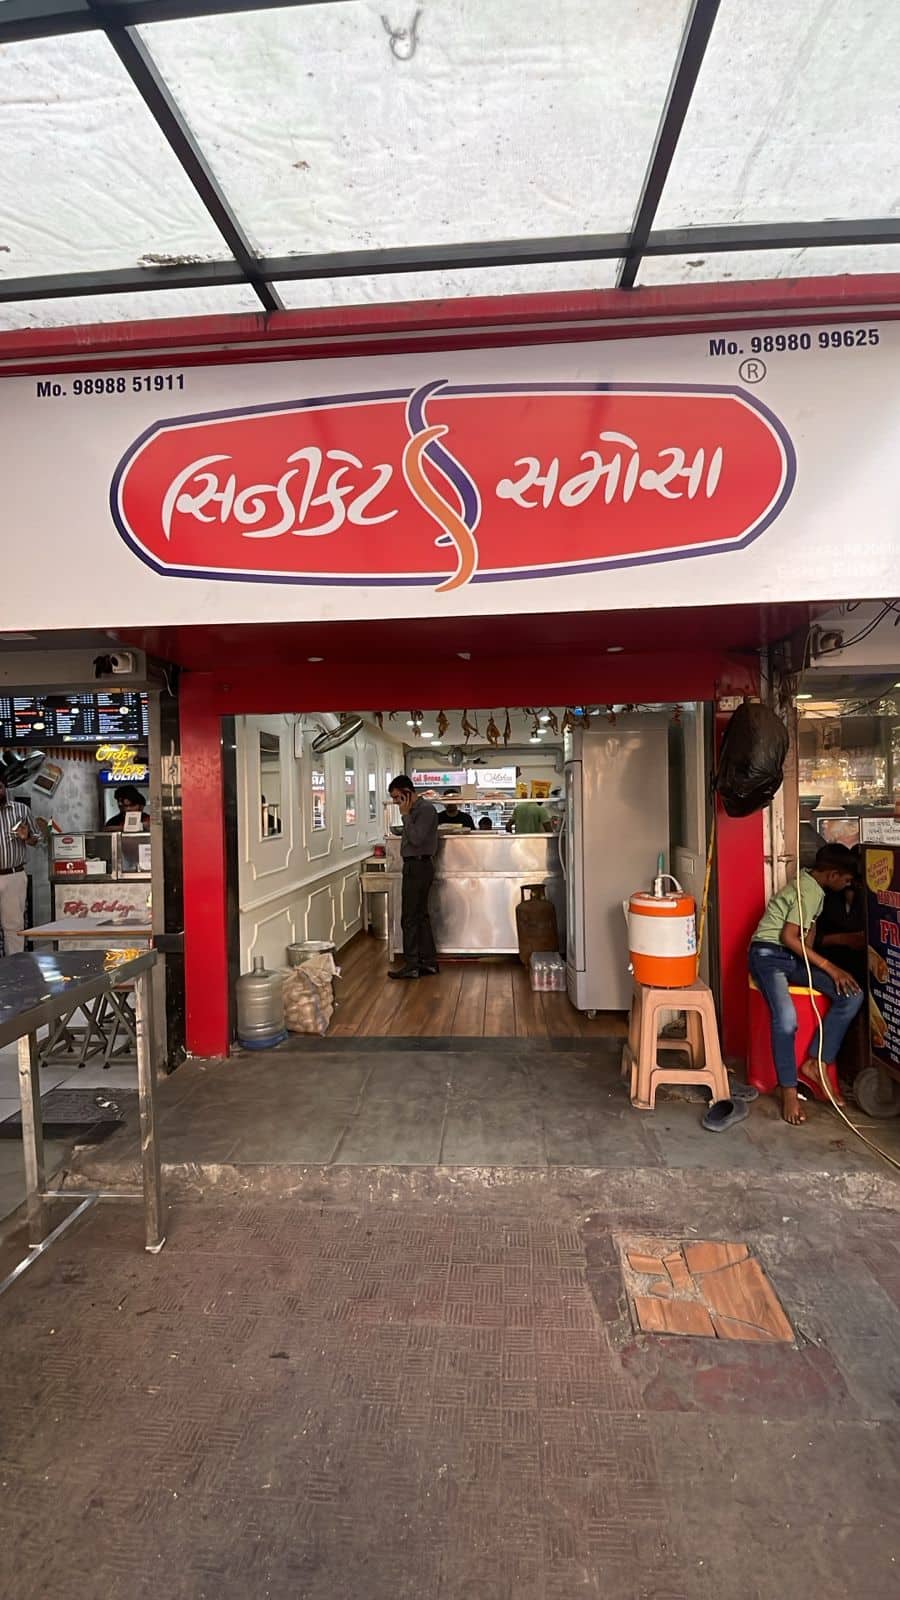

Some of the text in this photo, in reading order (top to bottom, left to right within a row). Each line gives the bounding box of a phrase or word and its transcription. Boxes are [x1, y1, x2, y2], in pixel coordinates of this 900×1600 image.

[709, 328, 880, 356] Mo. 98980 99625
[36, 373, 185, 398] Mo. 98988 51911
[495, 431, 723, 509] સમોસા
[95, 744, 137, 761] Order
[112, 761, 146, 775] Here
